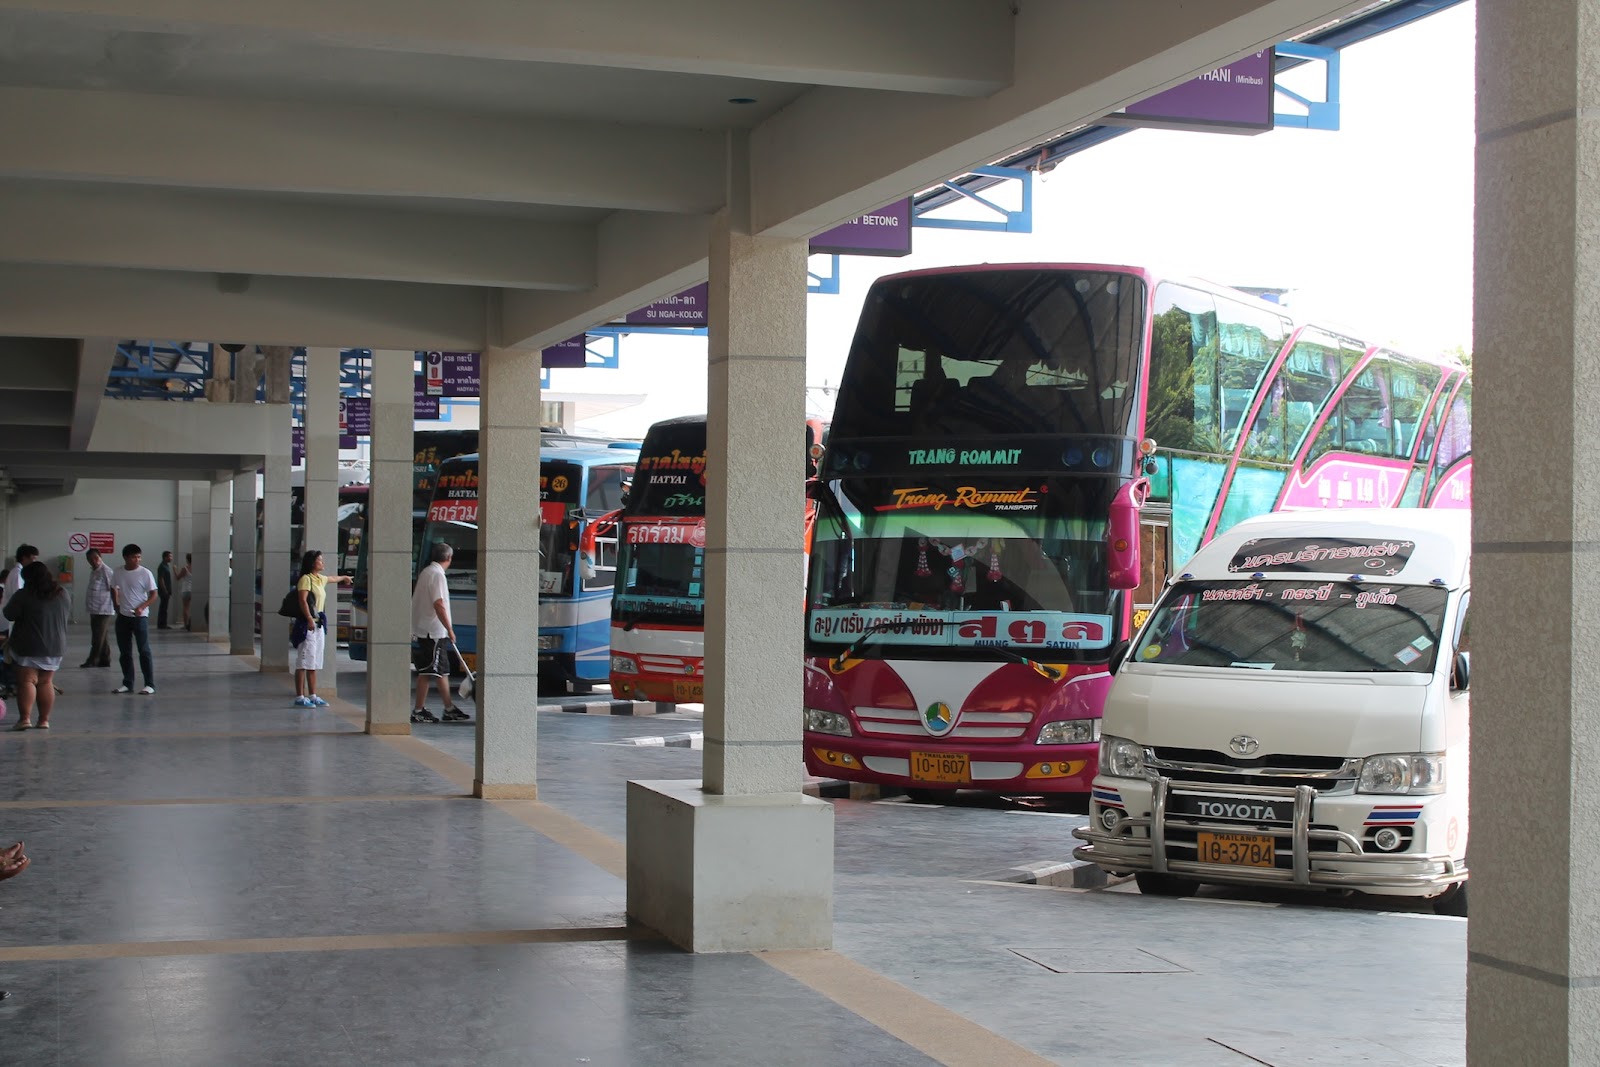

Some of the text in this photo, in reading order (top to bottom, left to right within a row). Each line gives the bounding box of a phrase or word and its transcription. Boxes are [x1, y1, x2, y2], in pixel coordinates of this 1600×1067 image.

[862, 215, 898, 226] BETONG
[646, 310, 703, 319] SU NGAI-KOLOK
[431, 354, 437, 363] 7
[908, 448, 1022, 465] TRANG ROMMIT
[649, 475, 687, 484] HATYAI
[892, 486, 1037, 511] Trang Rommit
[628, 519, 685, 544] รถร่วม
[973, 639, 1080, 650] MUANG SATUN
[916, 757, 965, 774] 10-1607
[1197, 801, 1277, 820] TOYOTA
[1213, 833, 1258, 842] THAILAND
[1203, 840, 1272, 865] 10-3704
